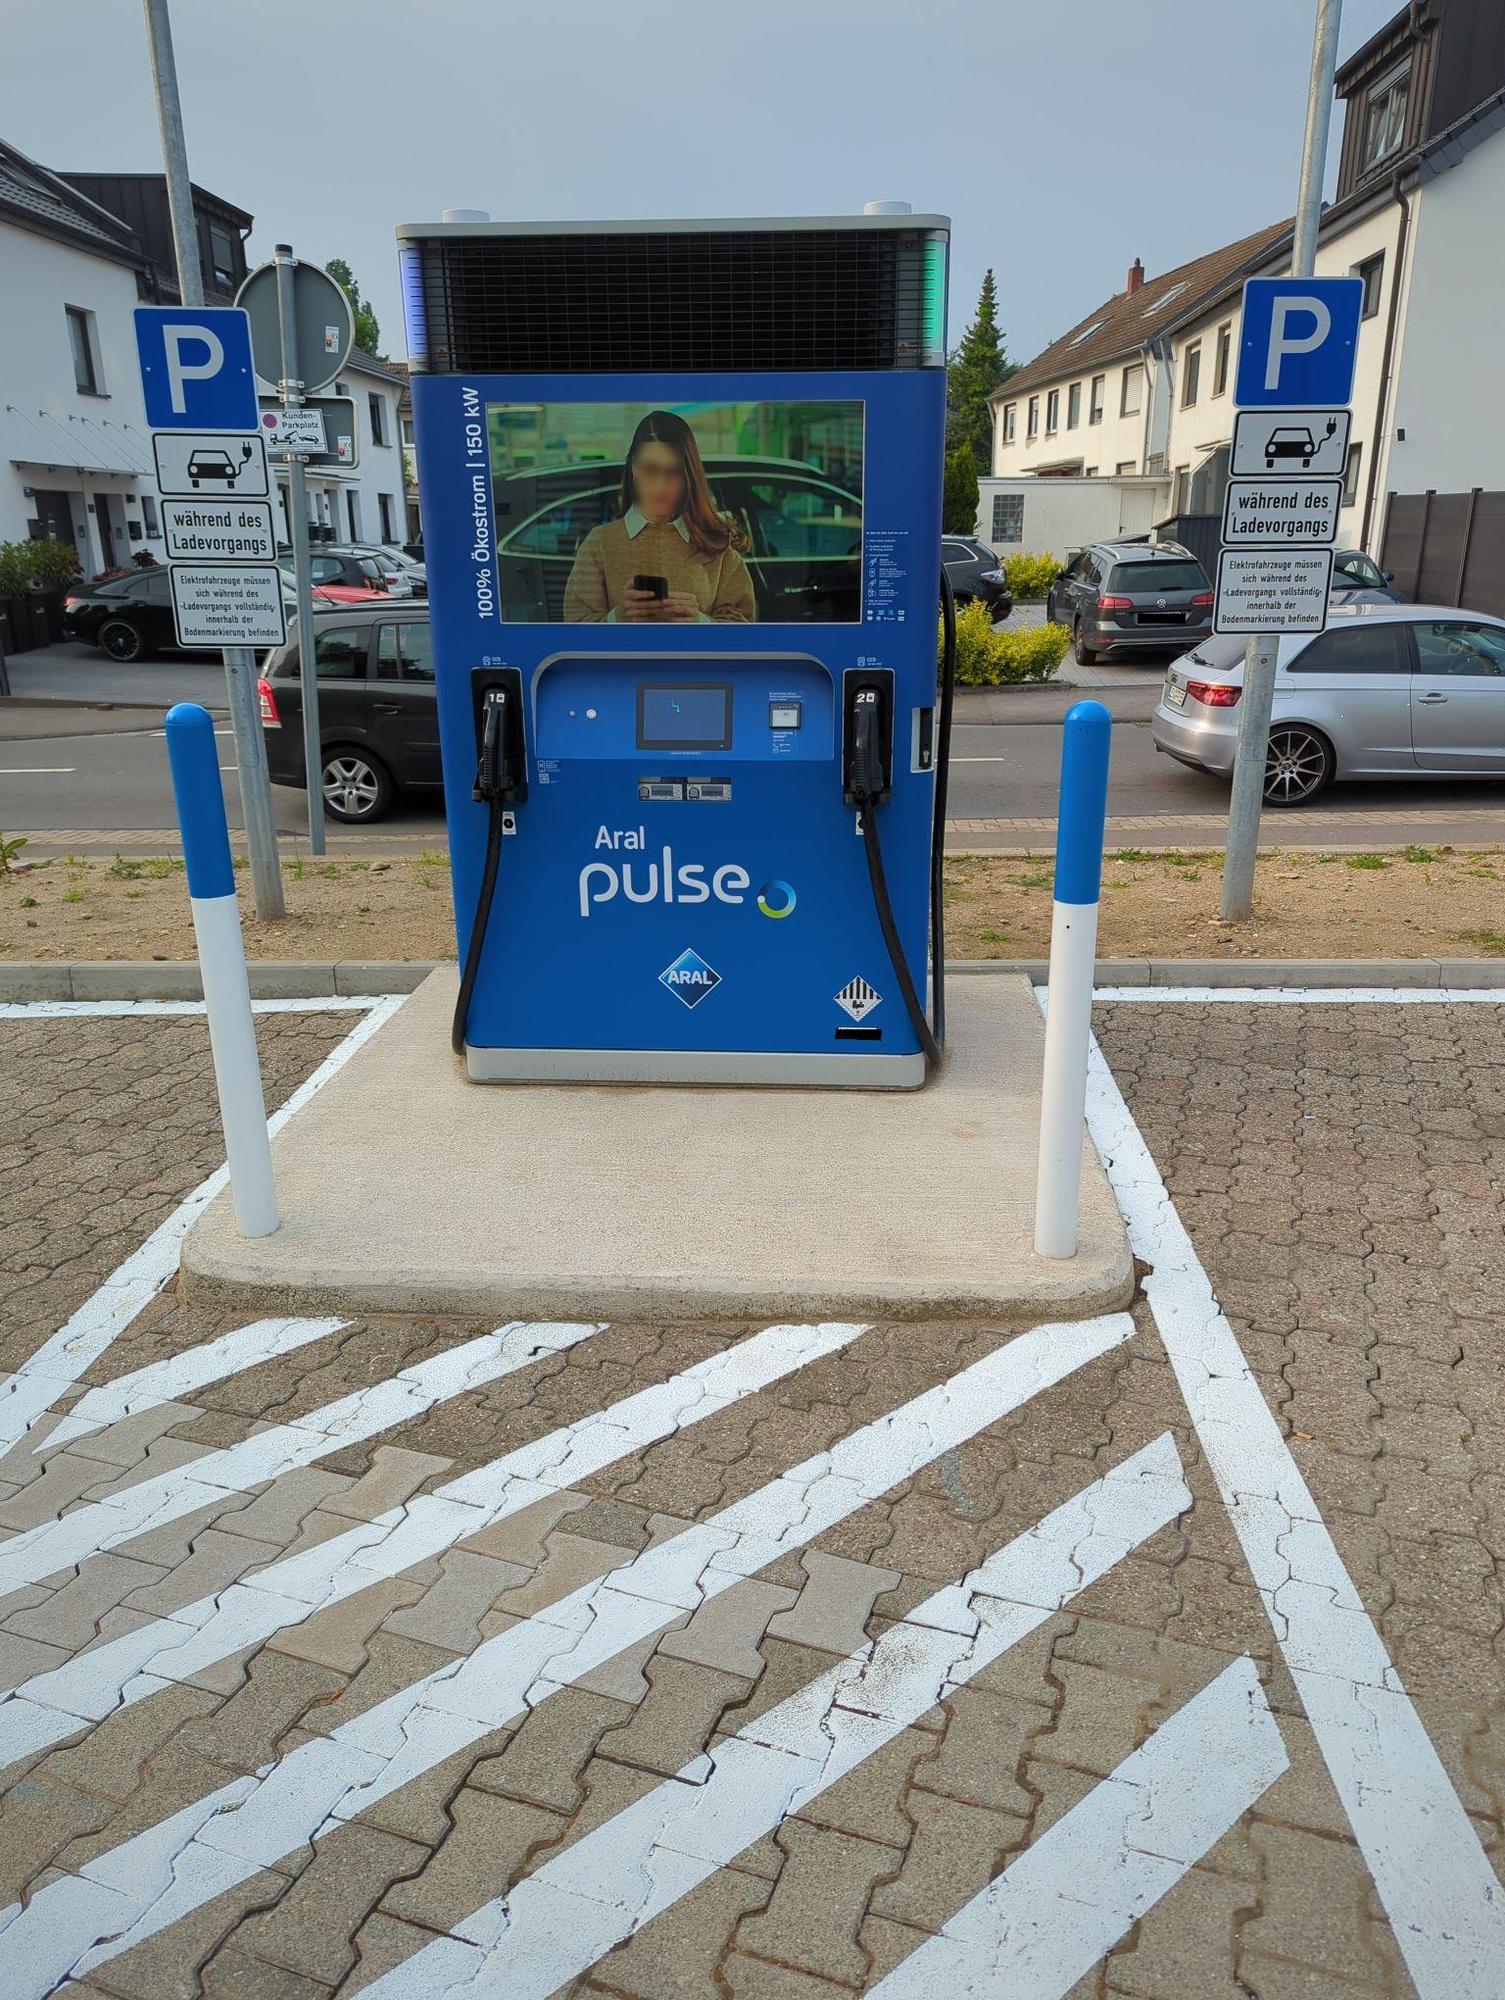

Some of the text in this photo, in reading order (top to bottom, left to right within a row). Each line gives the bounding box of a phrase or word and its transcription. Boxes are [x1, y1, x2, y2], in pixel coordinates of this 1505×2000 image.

[1264, 296, 1332, 390] P
[162, 324, 225, 413] P
[462, 386, 480, 417] kW
[282, 412, 316, 420] Kunden-
[282, 421, 320, 430] Parkplatz
[465, 423, 483, 457] 150
[1238, 491, 1329, 509] während des
[173, 510, 262, 528] während des
[471, 475, 490, 563] Ökostrom
[1232, 516, 1329, 538] Ladevorgangs
[173, 533, 268, 556] Ladevorgangs
[1229, 559, 1323, 571] Elektrofahrzeuge müssen
[180, 575, 272, 587] Elektrofahrzeuge müssen
[1242, 573, 1308, 583] sich während des
[195, 588, 260, 598] sich während des
[476, 568, 494, 619] 100%
[1225, 586, 1320, 599] Ladevorgangs vollständig
[182, 601, 232, 613] Ladevorgangs
[1246, 600, 1297, 610] innerhalb der
[205, 614, 255, 624] innerhalb der
[1221, 613, 1320, 626] Bodenmarkierung befinden
[184, 627, 280, 639] Bodenmarkierung befinden
[489, 693, 495, 703] 1
[856, 693, 866, 703] 2
[594, 825, 646, 850] Aral
[579, 845, 751, 917] pulse
[667, 970, 713, 985] ARAL
